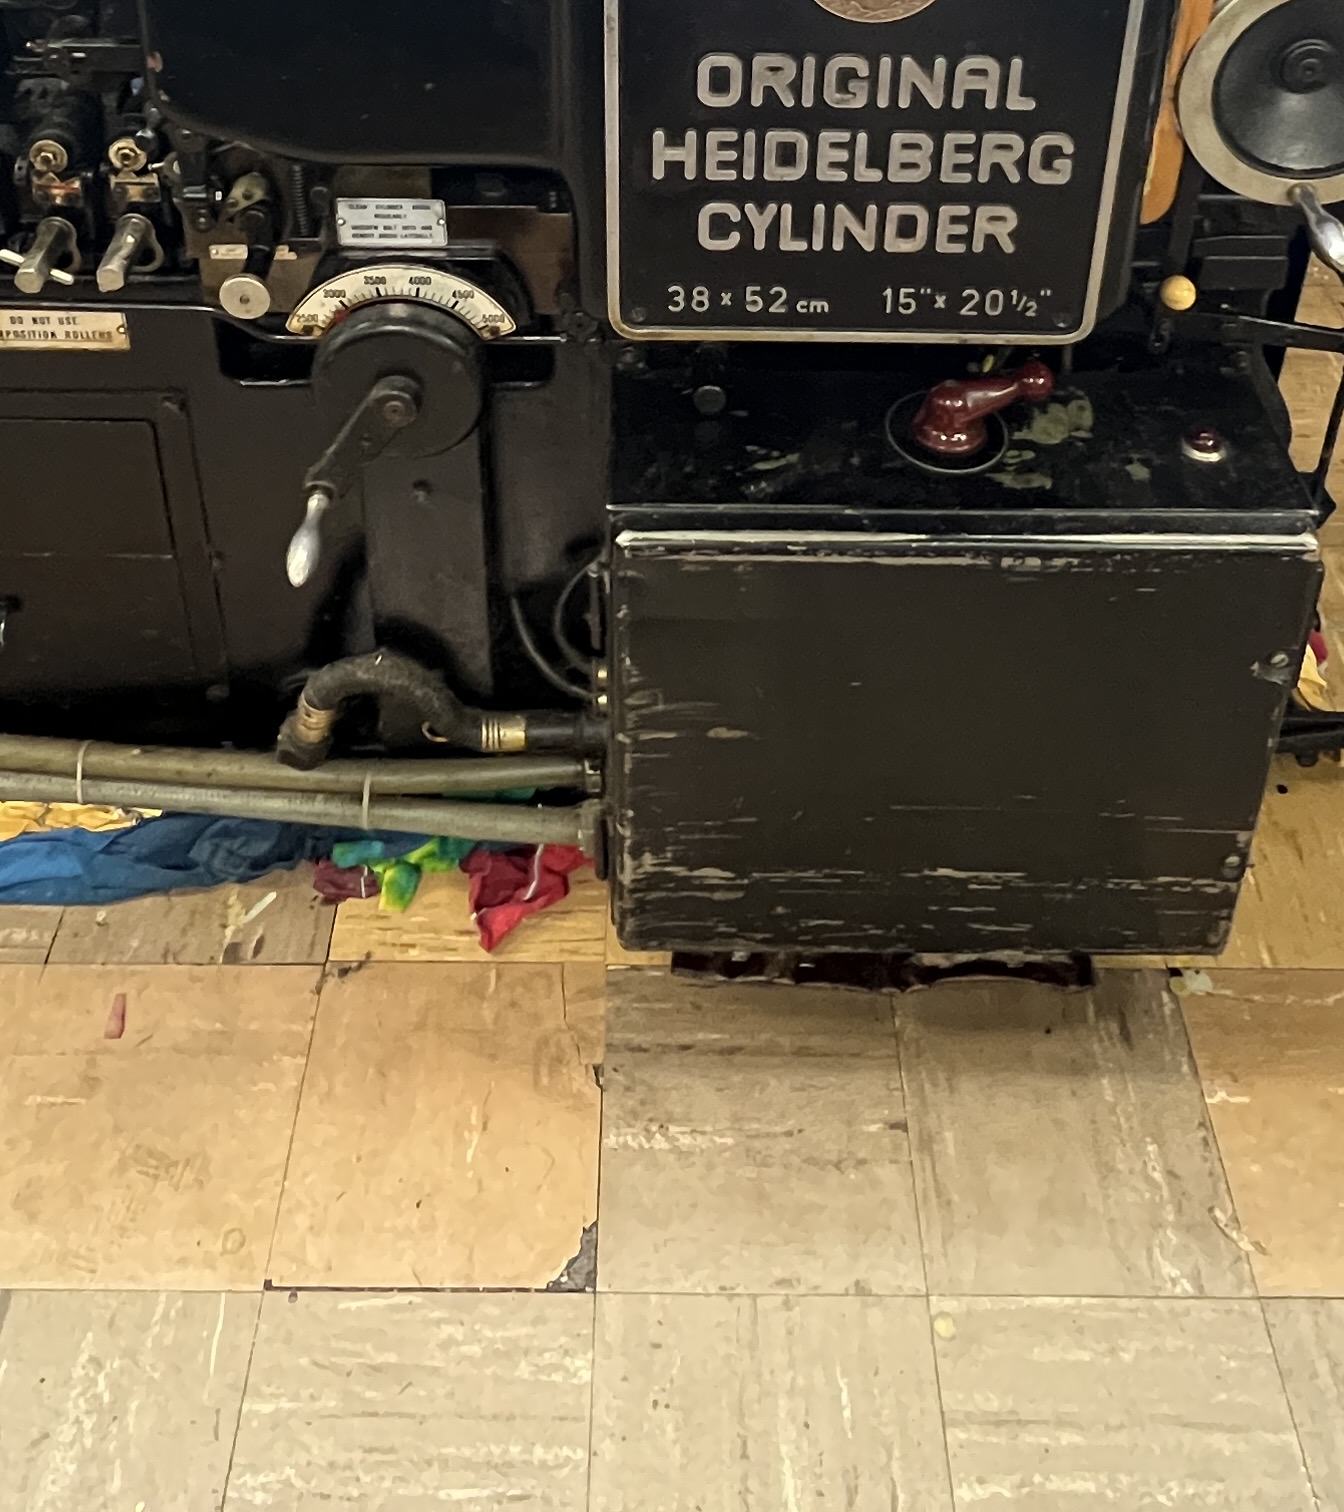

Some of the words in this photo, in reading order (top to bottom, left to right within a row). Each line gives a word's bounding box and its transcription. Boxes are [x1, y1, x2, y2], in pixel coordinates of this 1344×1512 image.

[696, 53, 1037, 112] ORIGINAL
[652, 128, 1076, 186] HEIDELBERG
[697, 201, 1019, 255] CYLINDER
[364, 275, 387, 286] 3500
[408, 275, 432, 286] 4000
[323, 288, 346, 299] 3000
[452, 288, 475, 300] 4500
[667, 285, 710, 314] 38
[744, 285, 787, 315] 52
[796, 298, 830, 315] cm
[9, 315, 24, 325] DO
[32, 316, 51, 325] NOT
[58, 317, 78, 326] USE
[296, 313, 319, 324] 2500
[482, 313, 506, 325] 5000
[64, 331, 113, 340] ROLLERS
